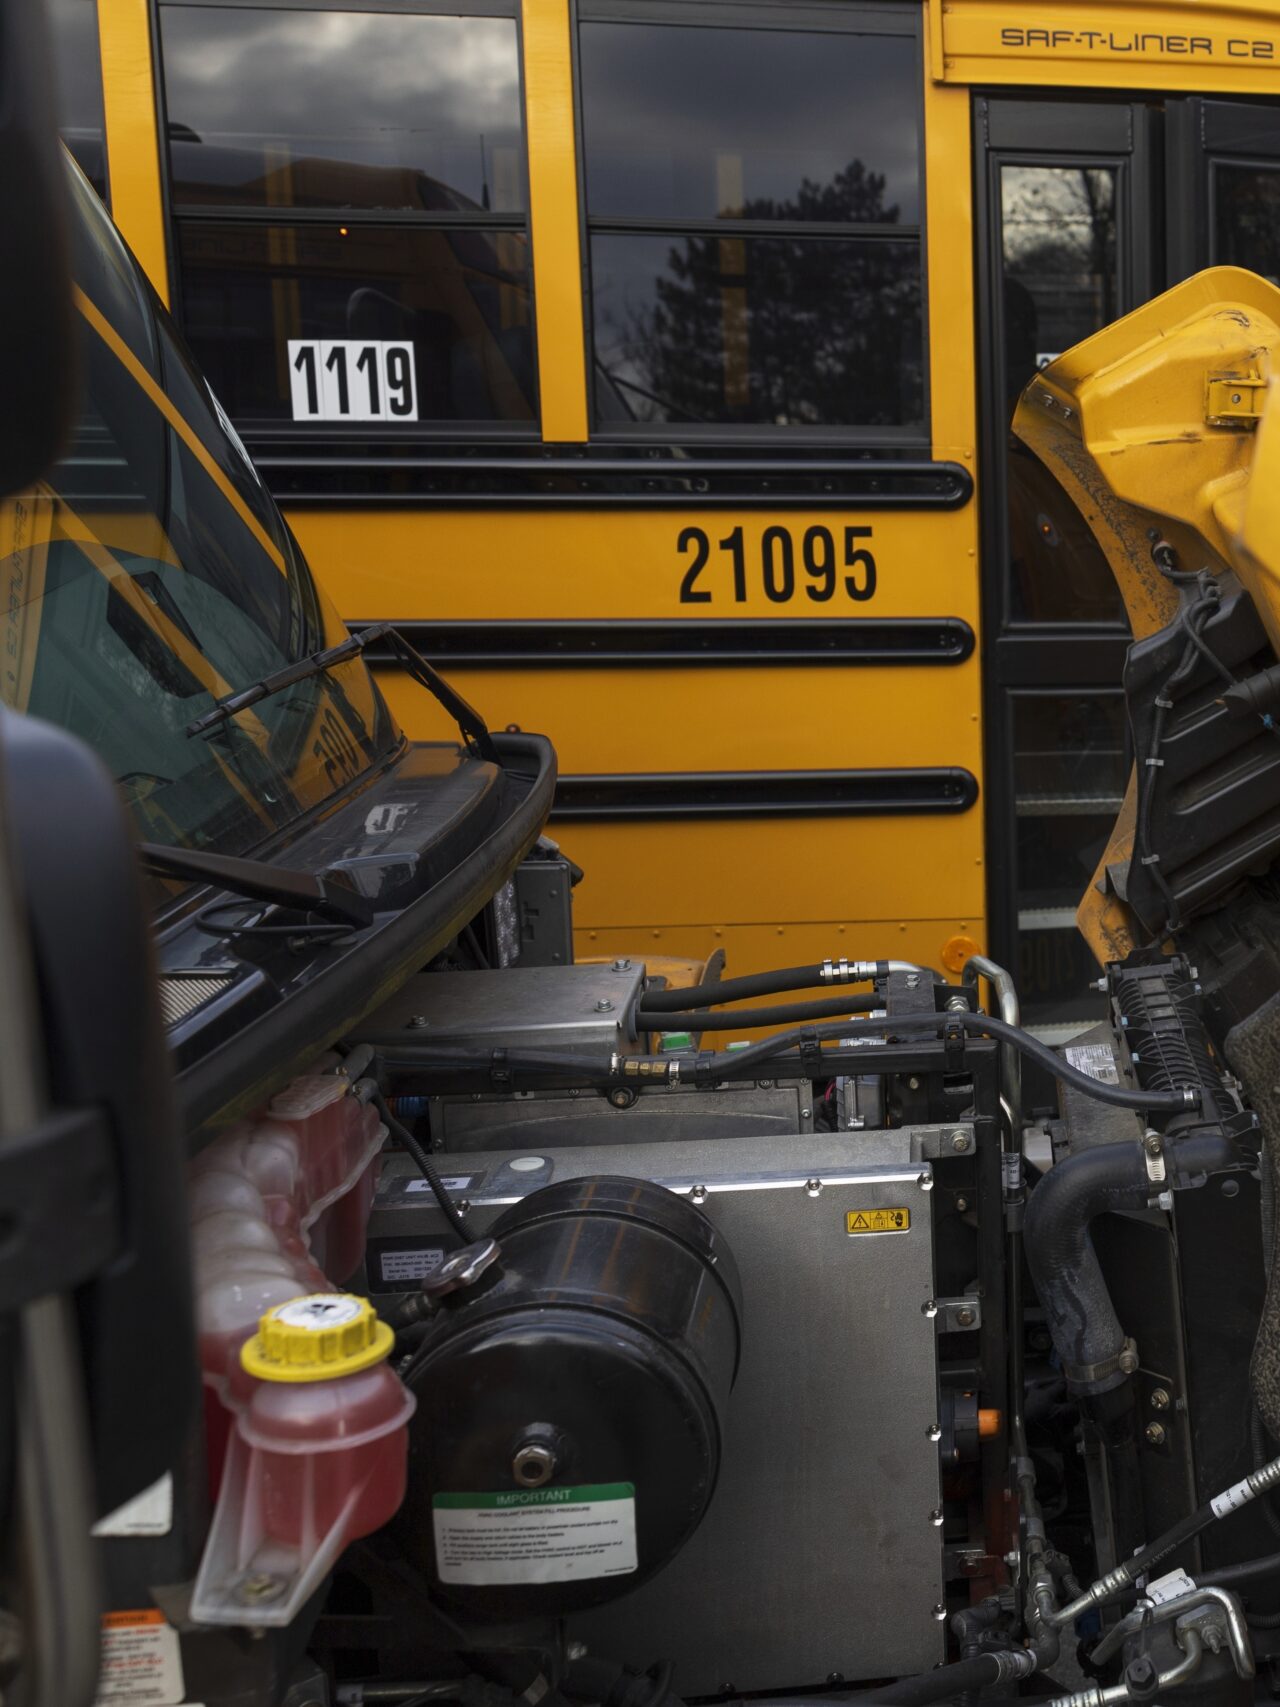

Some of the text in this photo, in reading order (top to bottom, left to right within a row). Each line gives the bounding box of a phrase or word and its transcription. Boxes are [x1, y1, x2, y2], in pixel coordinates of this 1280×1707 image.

[1001, 28, 1274, 59] SAF-T-LINER C2
[294, 346, 413, 416] 1119
[677, 525, 877, 603] 21095
[496, 1490, 572, 1505] IMPORTANT
